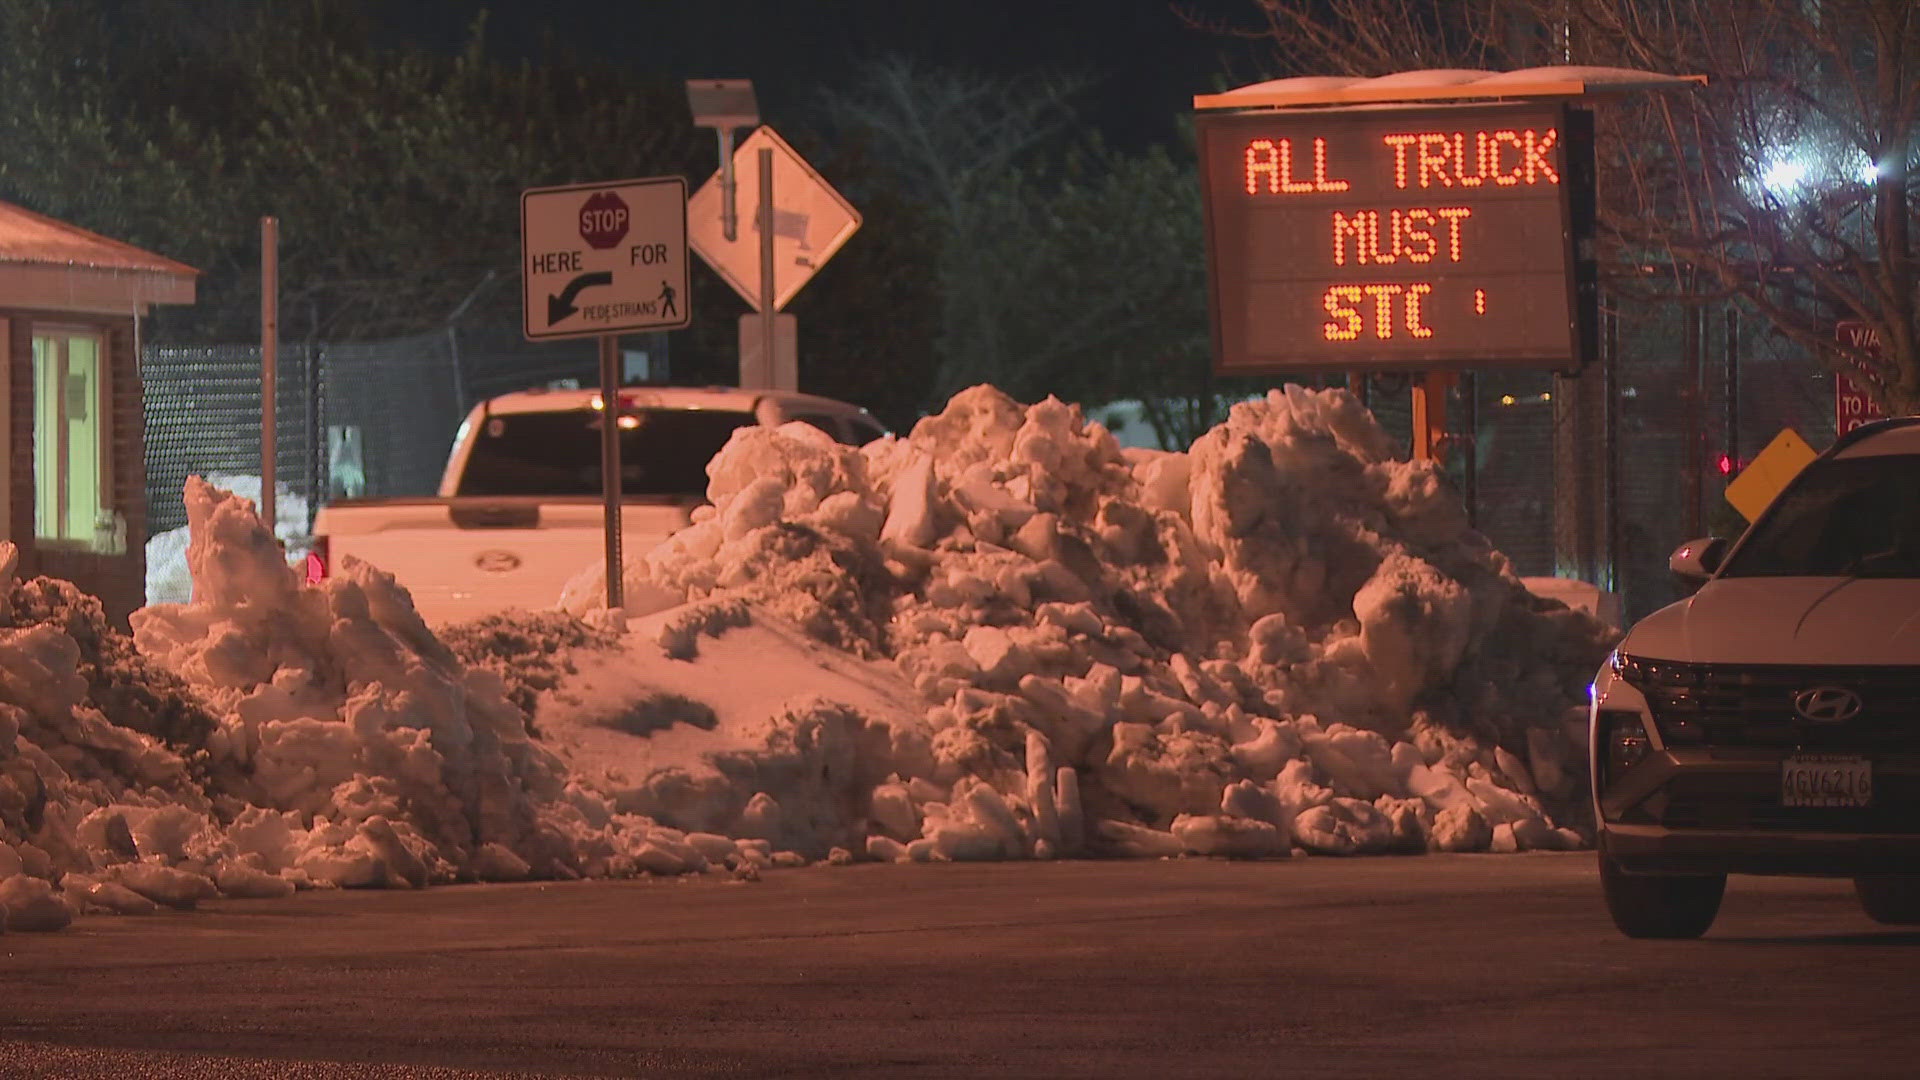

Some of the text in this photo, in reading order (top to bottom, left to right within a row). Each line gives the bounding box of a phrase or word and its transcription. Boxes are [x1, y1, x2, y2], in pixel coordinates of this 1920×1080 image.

[1245, 127, 1561, 195] ALL TRUCK
[581, 208, 629, 235] STOP
[1332, 207, 1472, 266] MUST
[532, 244, 668, 275] HERE FOR
[582, 301, 658, 321] PEDESTRIANS
[1842, 395, 1862, 416] TO
